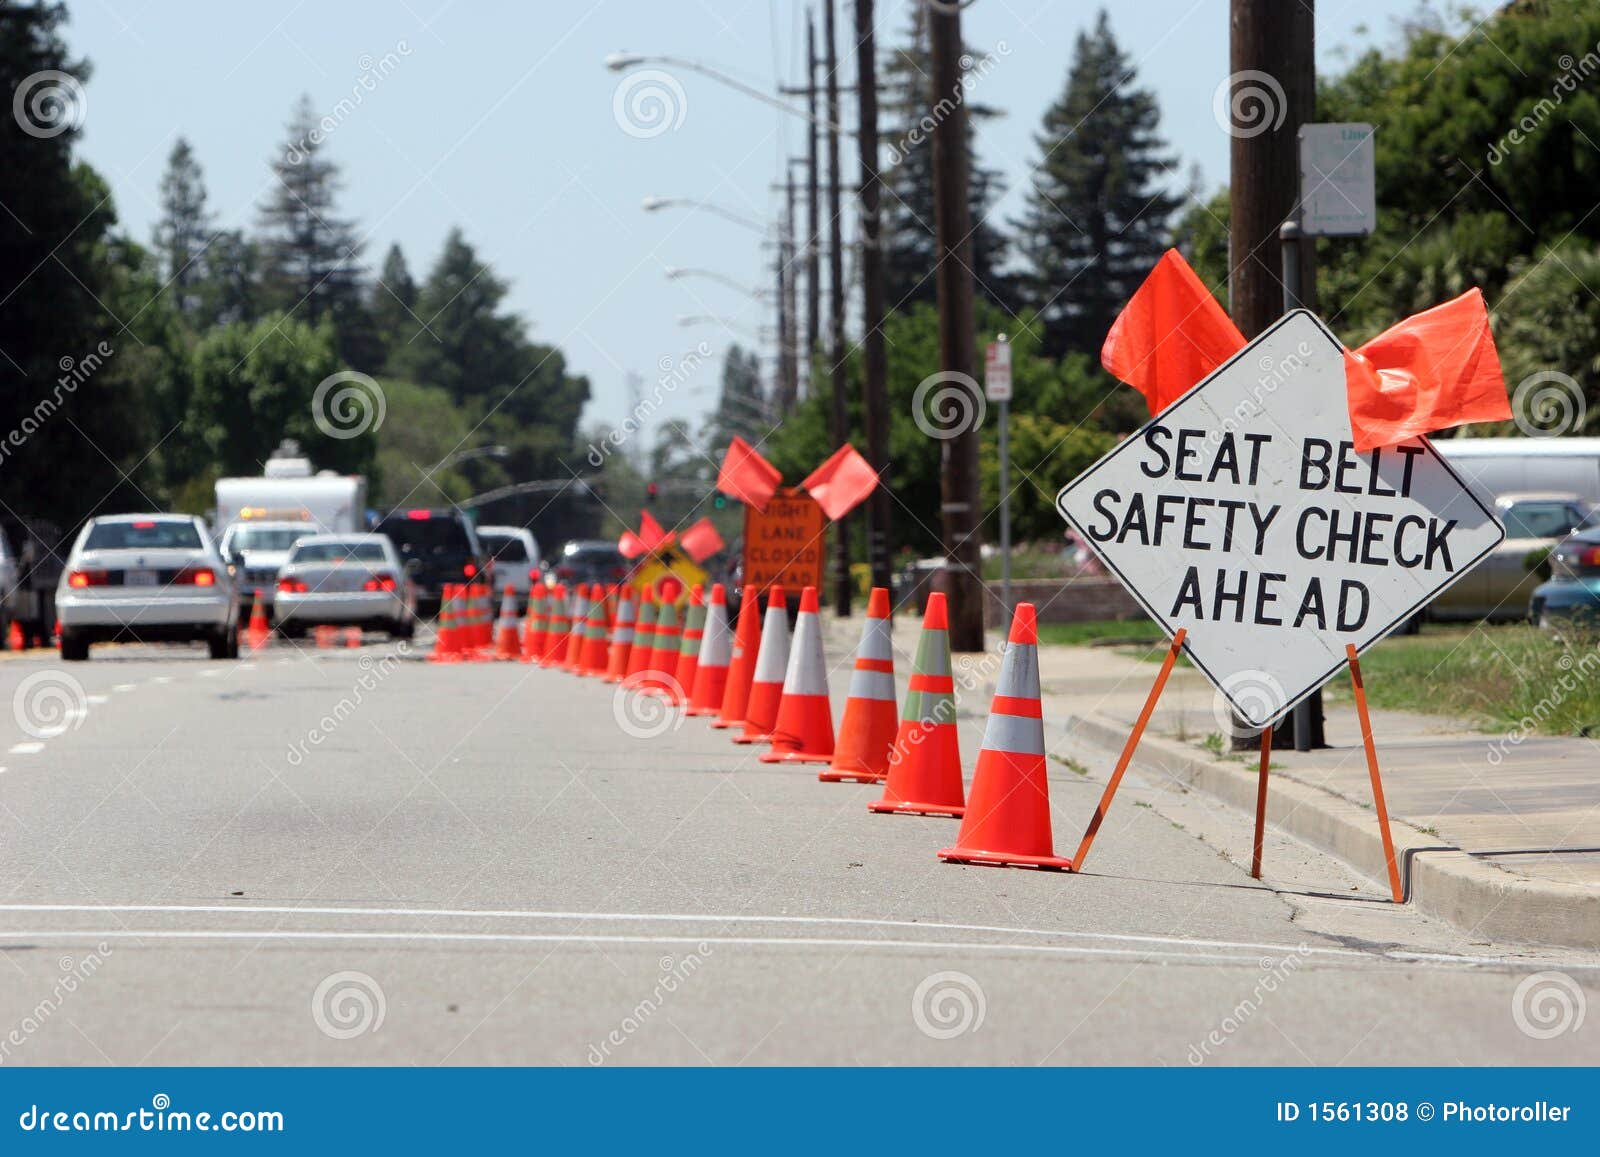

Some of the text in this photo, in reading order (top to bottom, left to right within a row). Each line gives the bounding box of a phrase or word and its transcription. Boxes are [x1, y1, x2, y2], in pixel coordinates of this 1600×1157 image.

[1140, 425, 1425, 499] SEAT BELT
[761, 526, 805, 540] LANE
[1087, 489, 1459, 572] SAFETY CHECK
[1170, 565, 1370, 632] AHEAD
